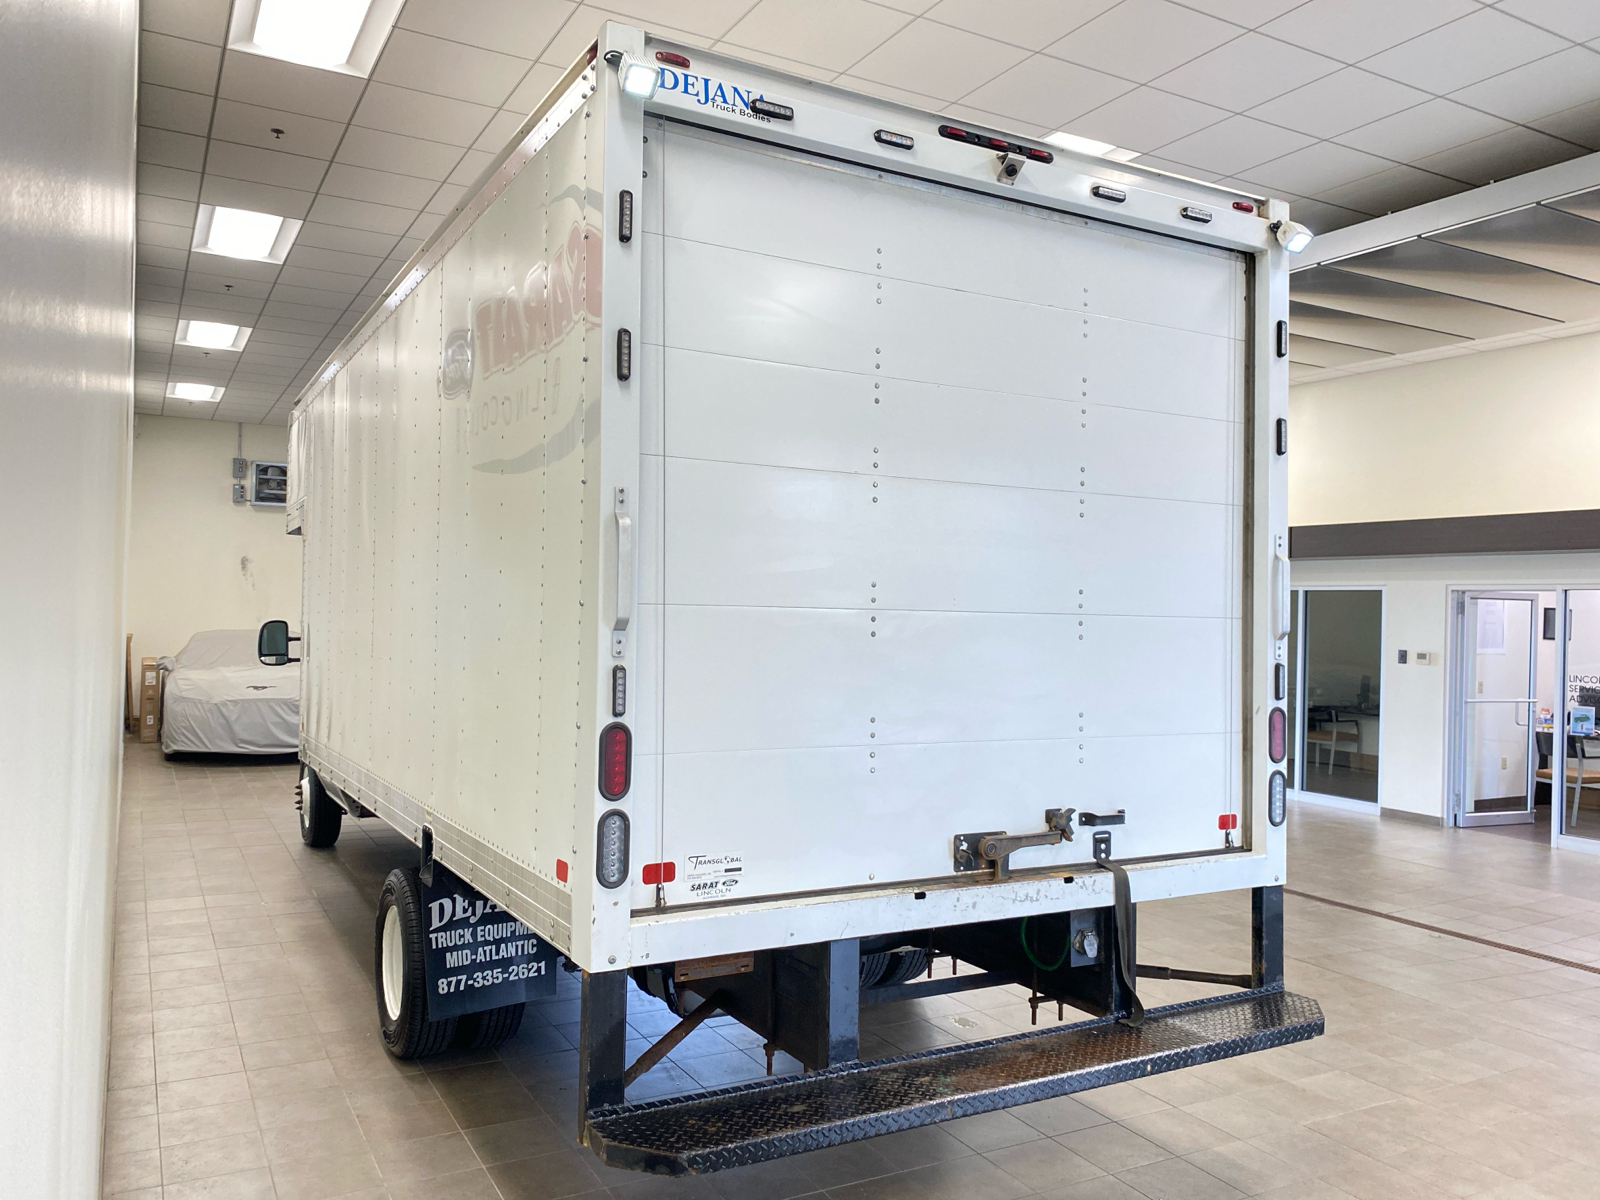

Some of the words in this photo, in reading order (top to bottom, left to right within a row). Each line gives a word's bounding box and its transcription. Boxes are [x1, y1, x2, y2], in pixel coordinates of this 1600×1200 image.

[711, 101, 737, 115] Truck
[739, 108, 771, 123] Bodies
[690, 881, 720, 892] SARAT
[696, 887, 732, 897] LINCOLN
[429, 927, 474, 950] TRUCK
[445, 938, 538, 969] MID-ATLANTIC
[437, 960, 547, 995] 877-335-2621
